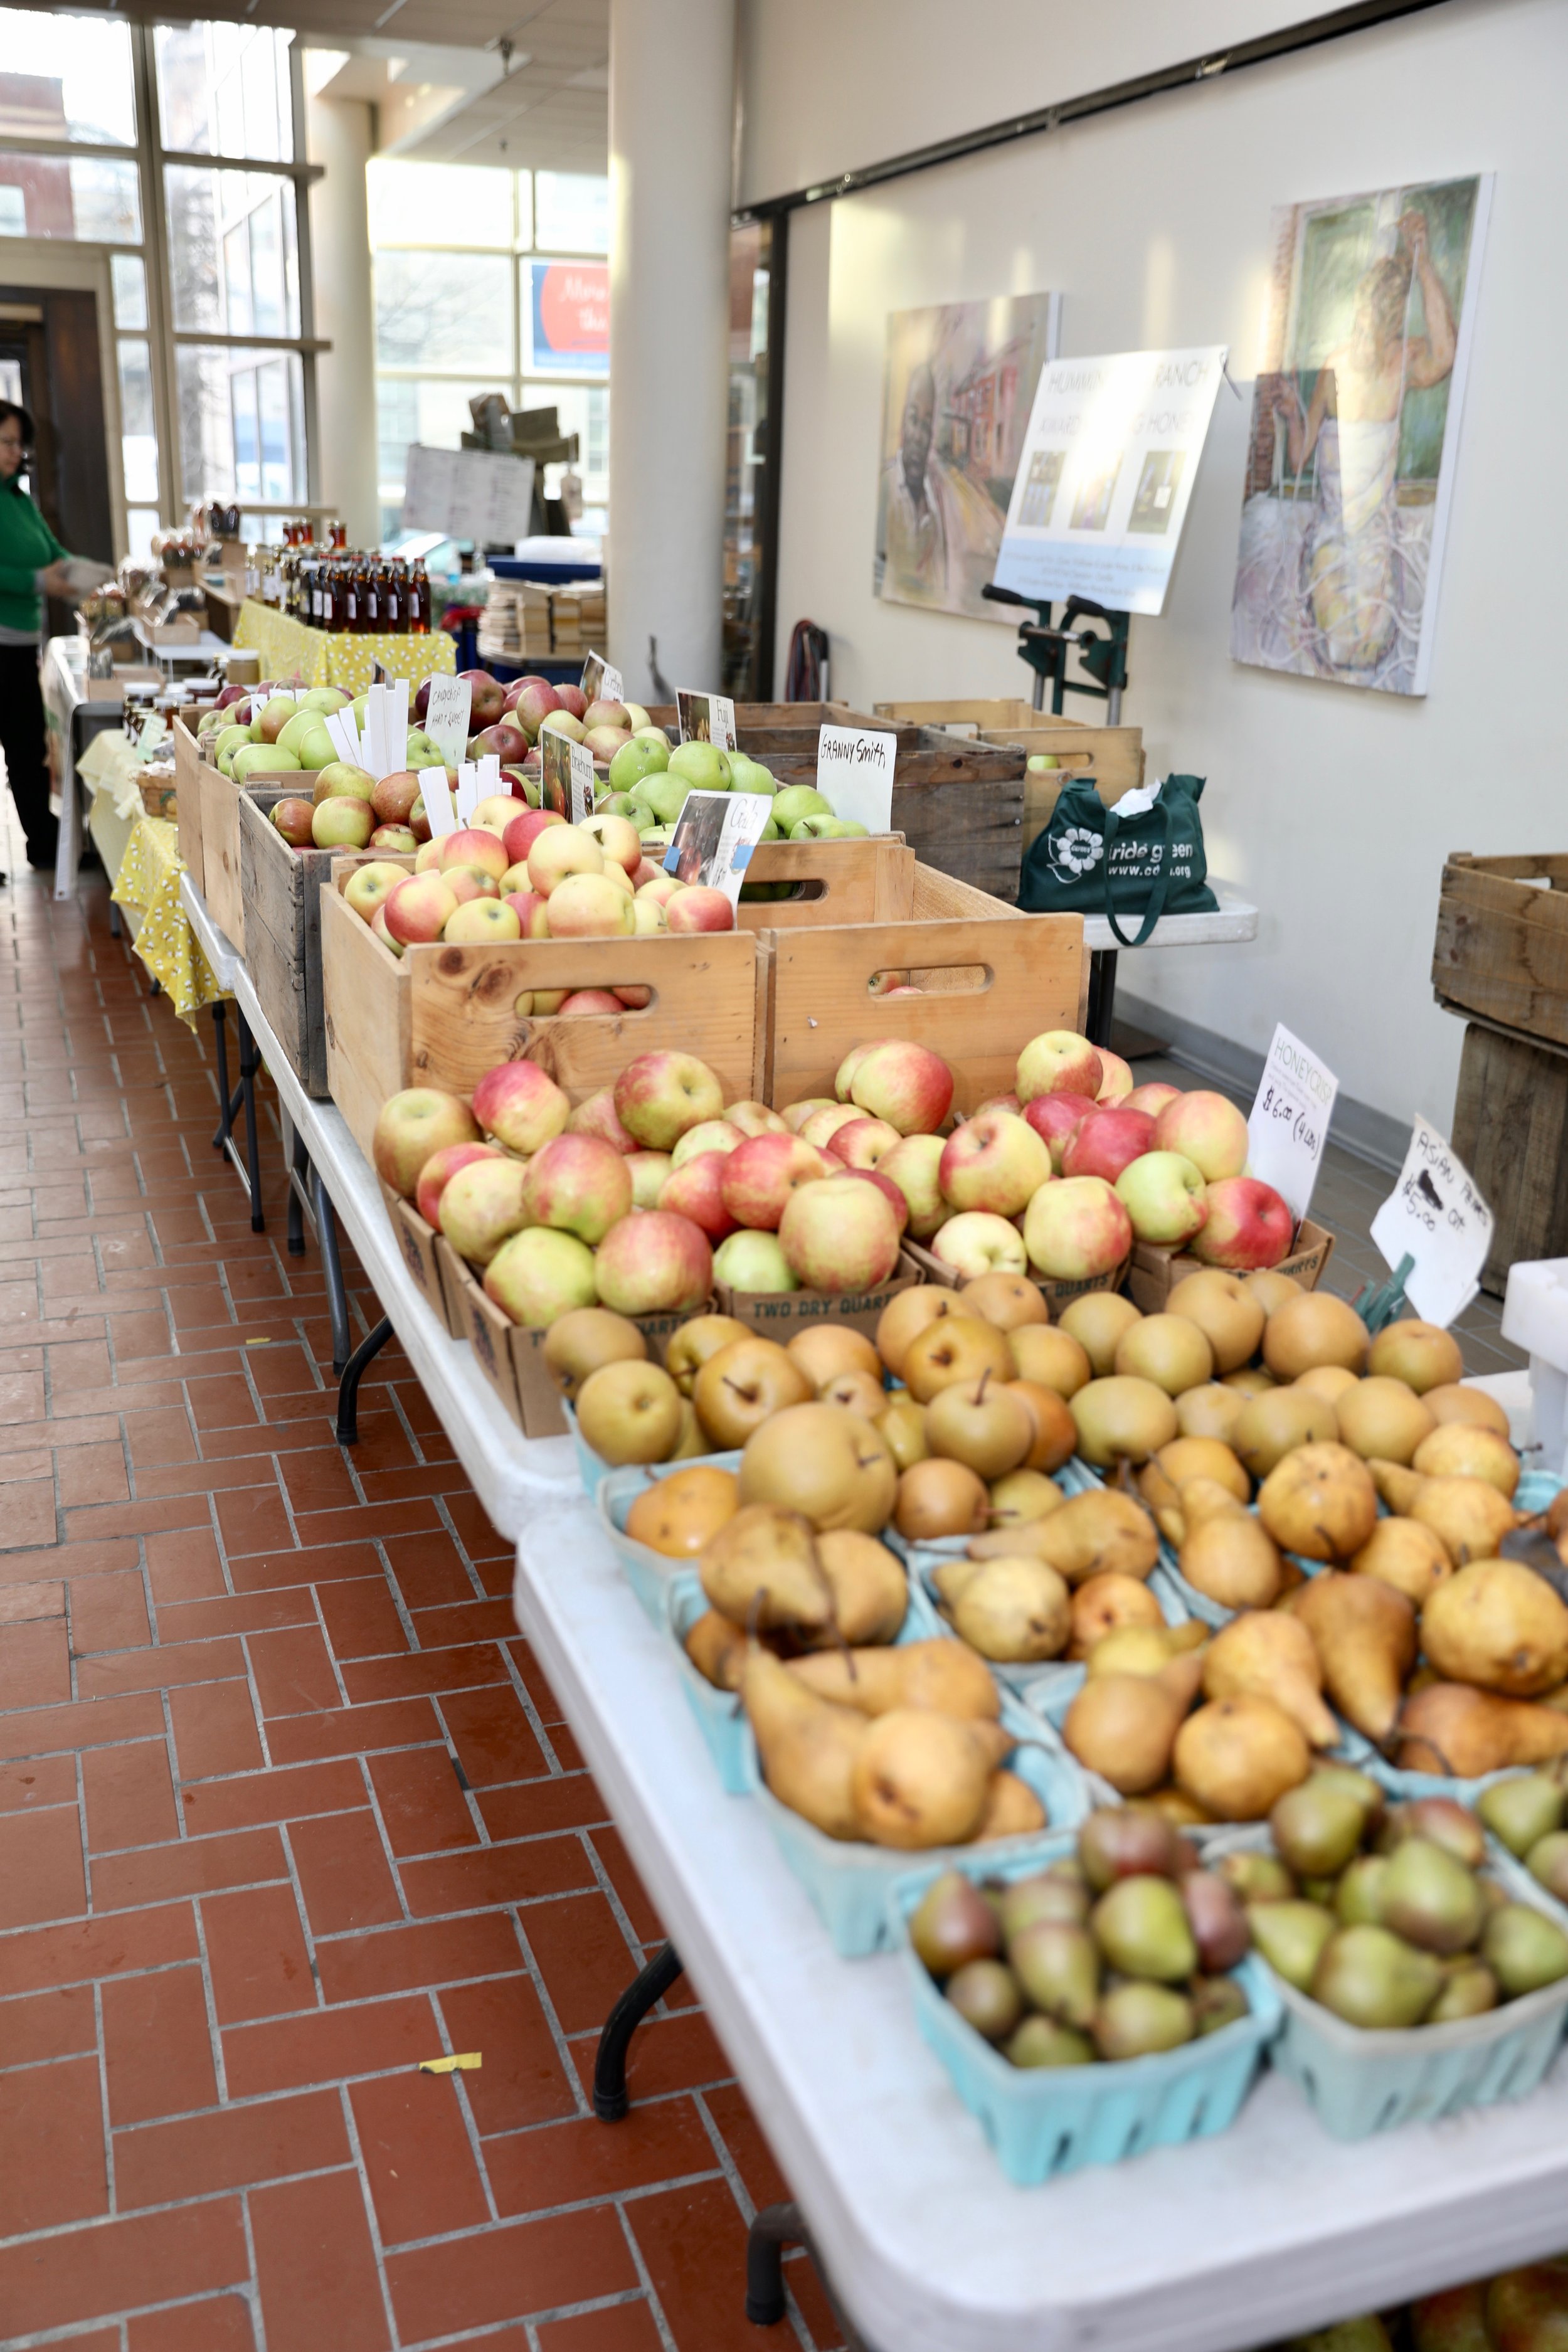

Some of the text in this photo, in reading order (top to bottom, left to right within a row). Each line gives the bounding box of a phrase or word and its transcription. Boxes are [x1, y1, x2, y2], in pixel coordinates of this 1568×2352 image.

[716, 699, 729, 728] Fuji
[571, 746, 593, 780] Braeburn
[820, 733, 886, 770] GRANNY Smith
[730, 798, 758, 829] Gala
[1108, 864, 1192, 878] www.cd.org
[1274, 1037, 1332, 1105] HONEYCRISP
[755, 1291, 898, 1318] TWO DRY QUART
